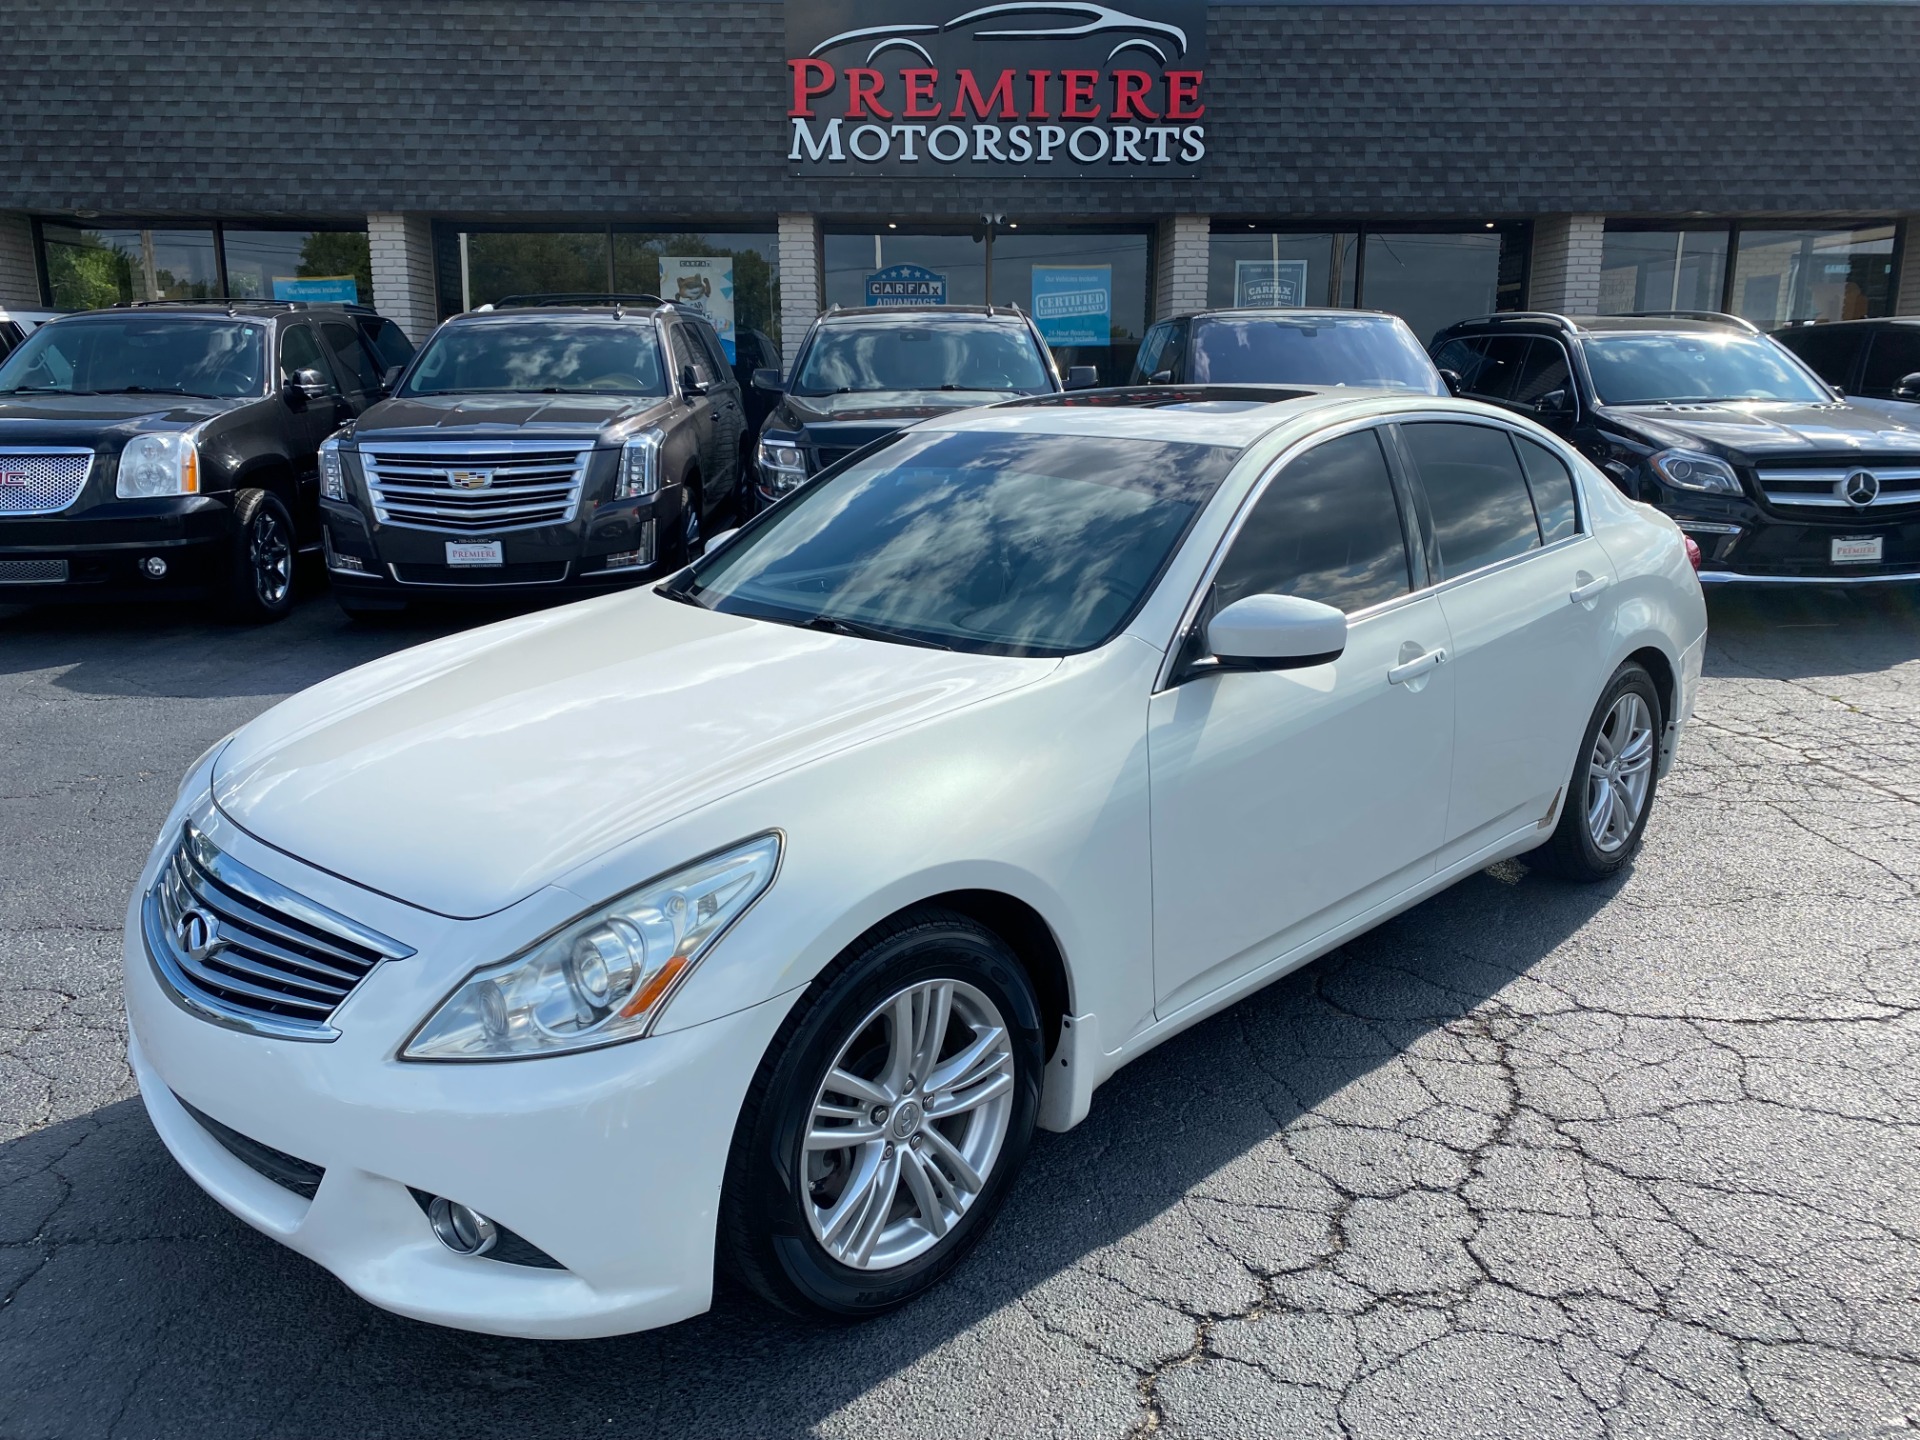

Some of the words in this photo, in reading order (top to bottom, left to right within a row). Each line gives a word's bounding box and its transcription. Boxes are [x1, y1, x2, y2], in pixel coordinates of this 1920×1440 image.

[787, 58, 1206, 120] PREMIERE
[787, 118, 1206, 163] MOTORSPORTS
[872, 283, 940, 296] CARFAX
[1039, 292, 1105, 309] CERTIFIED
[1040, 308, 1067, 316] LIMITED
[1068, 304, 1104, 314] WARRANTY
[1837, 547, 1876, 555] PREMIERE
